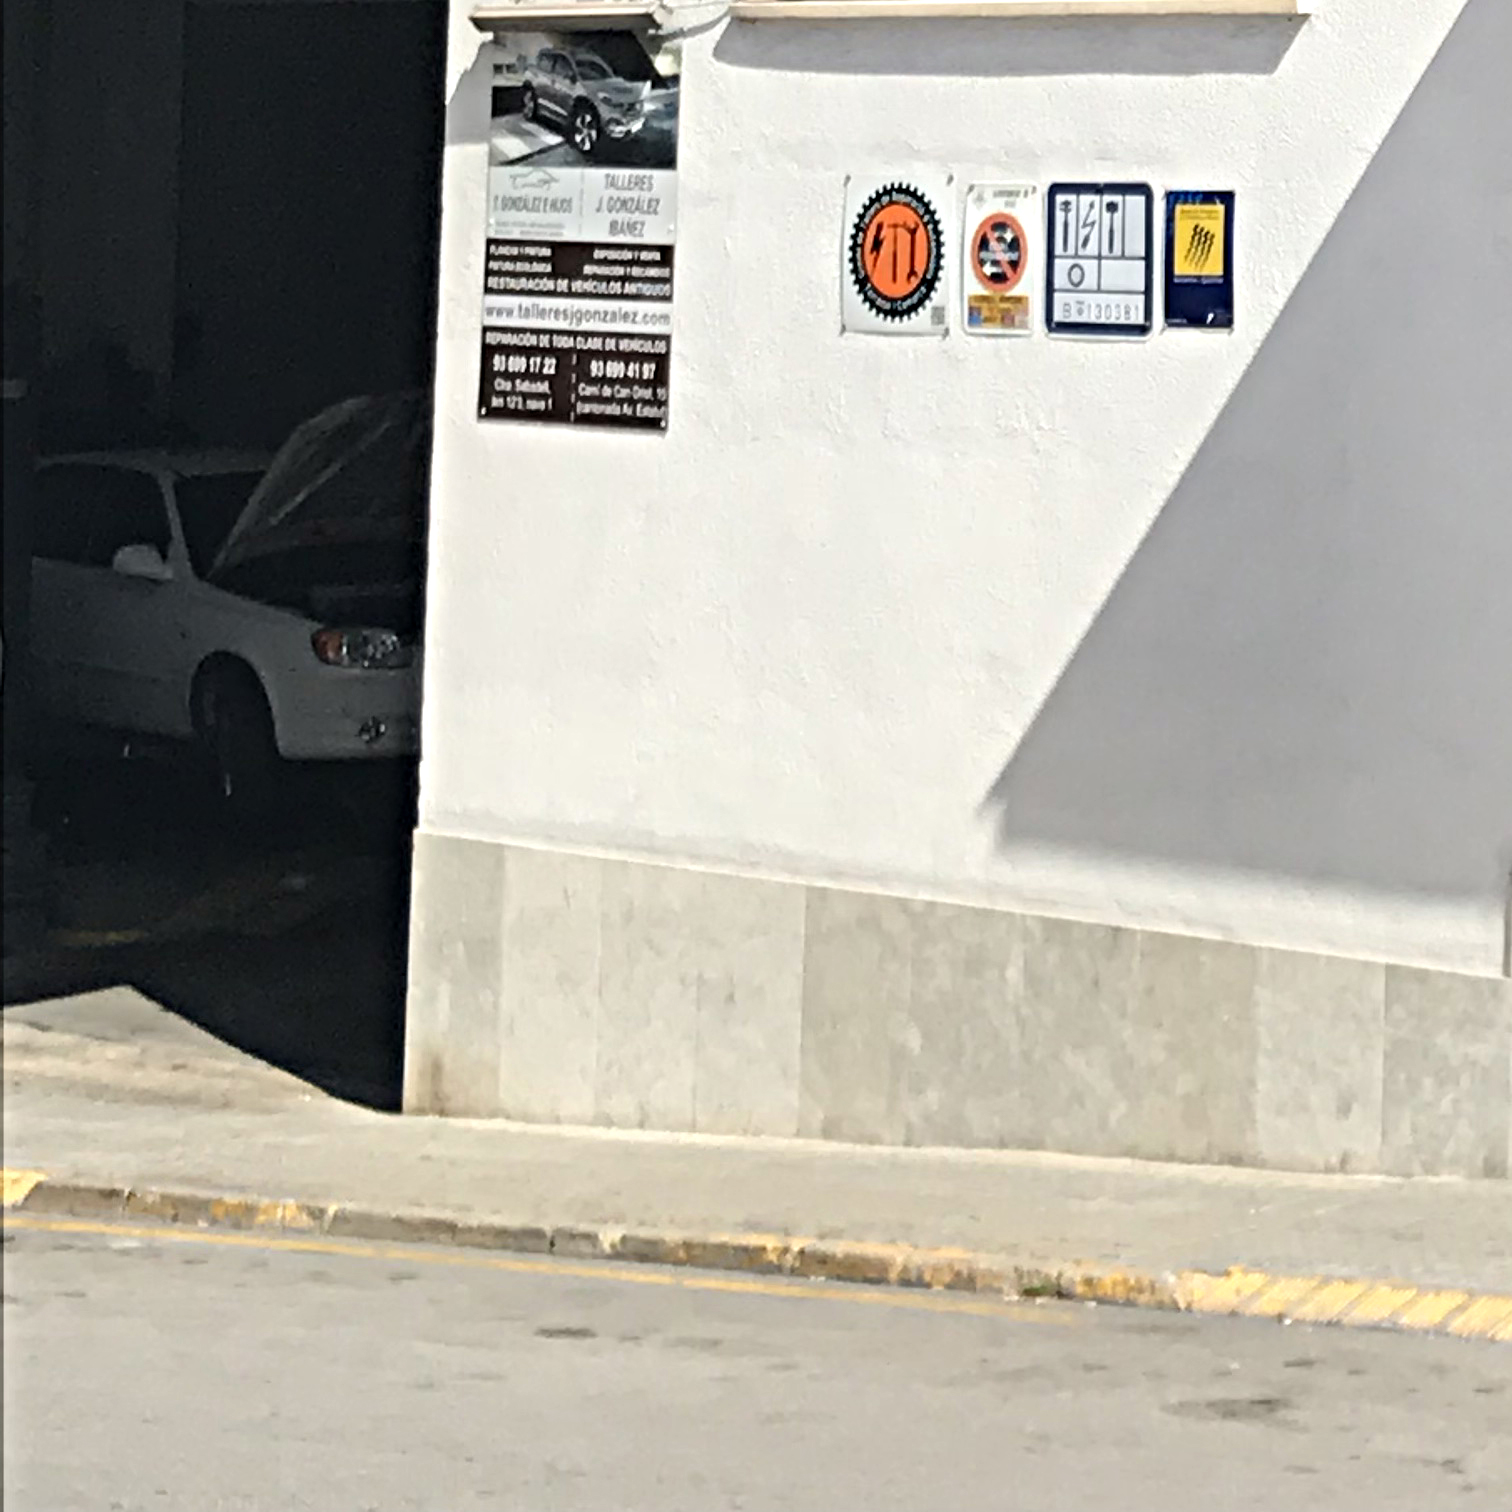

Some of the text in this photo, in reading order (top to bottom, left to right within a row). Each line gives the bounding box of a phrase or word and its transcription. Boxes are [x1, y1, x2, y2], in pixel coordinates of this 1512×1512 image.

[604, 173, 654, 192] TALLERES
[607, 195, 661, 216] GONZÁLEZ
[485, 303, 671, 327] www.talleresjgonzalez.com
